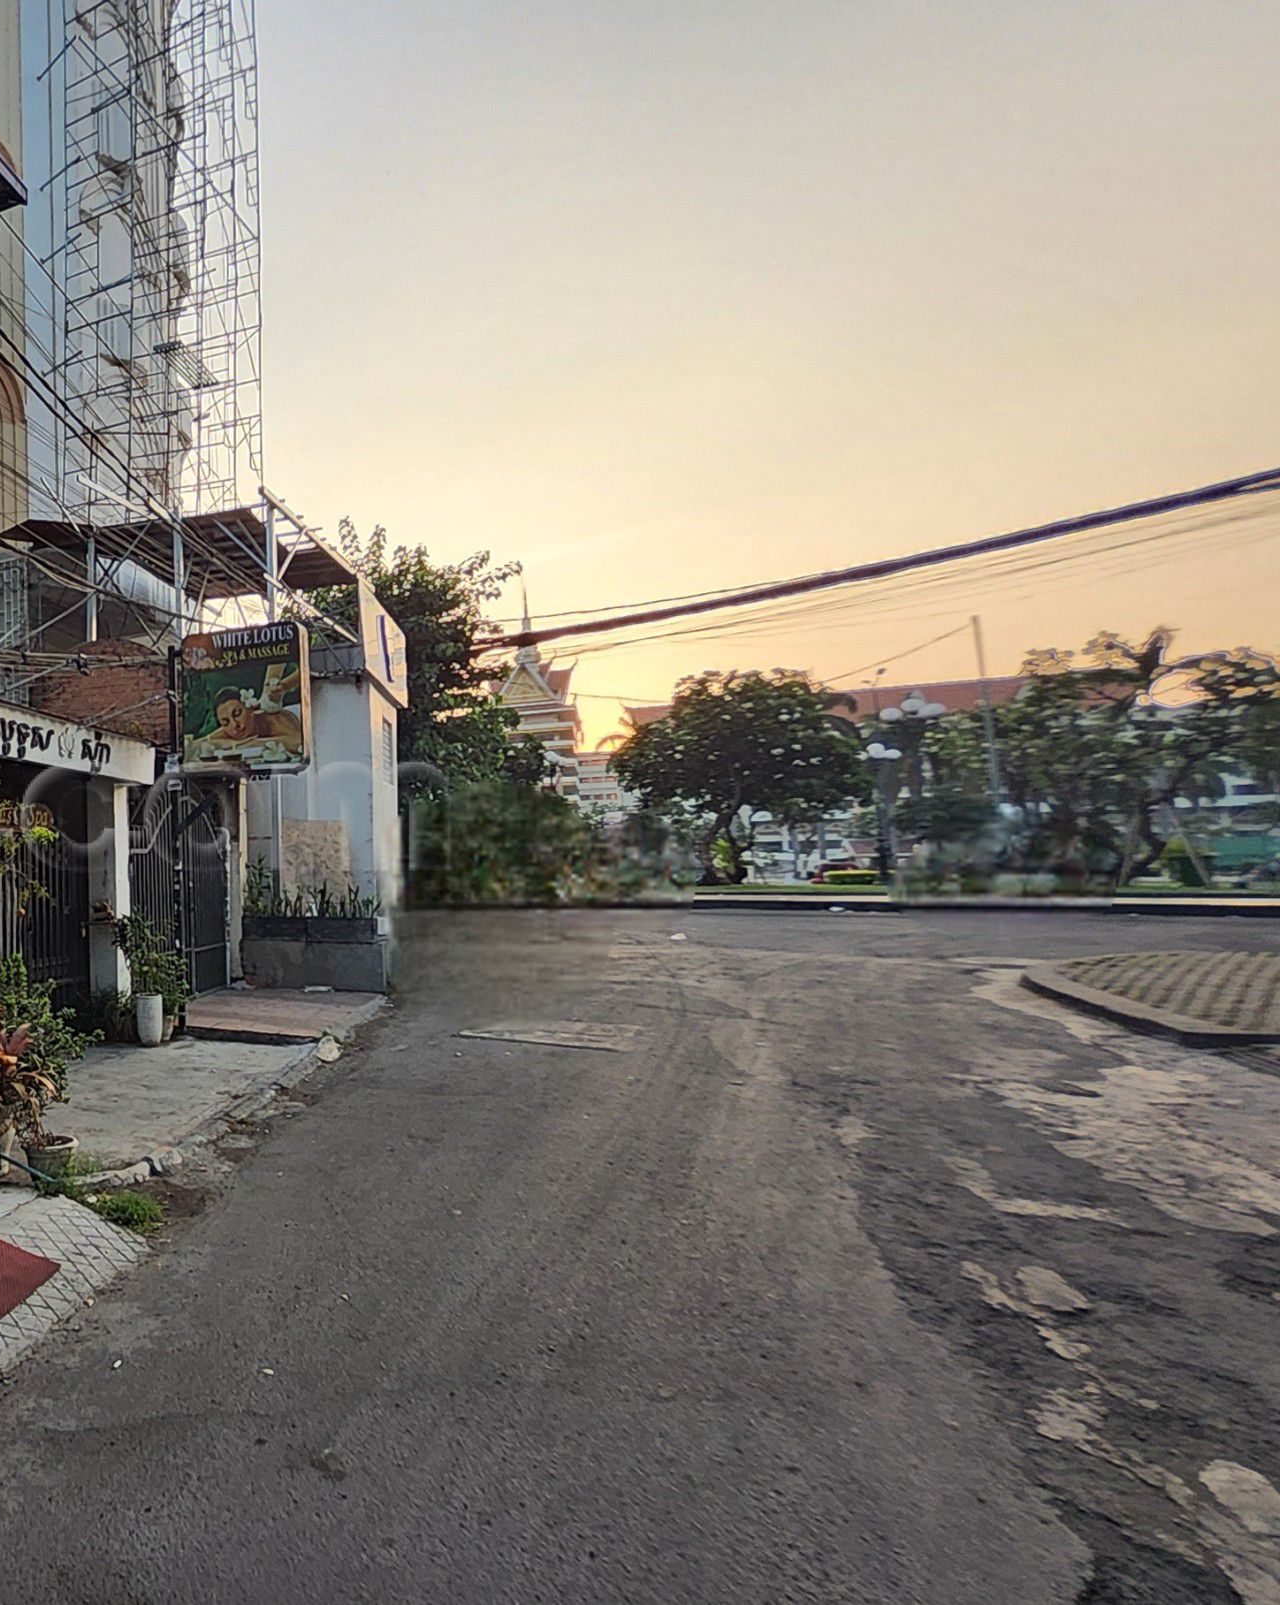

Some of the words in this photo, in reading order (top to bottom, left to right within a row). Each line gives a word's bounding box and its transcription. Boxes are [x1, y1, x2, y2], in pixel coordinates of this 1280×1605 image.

[212, 631, 251, 649] WHITE
[254, 624, 294, 643] LOTUS
[222, 648, 238, 661] SPA
[248, 643, 291, 658] MASSAGE
